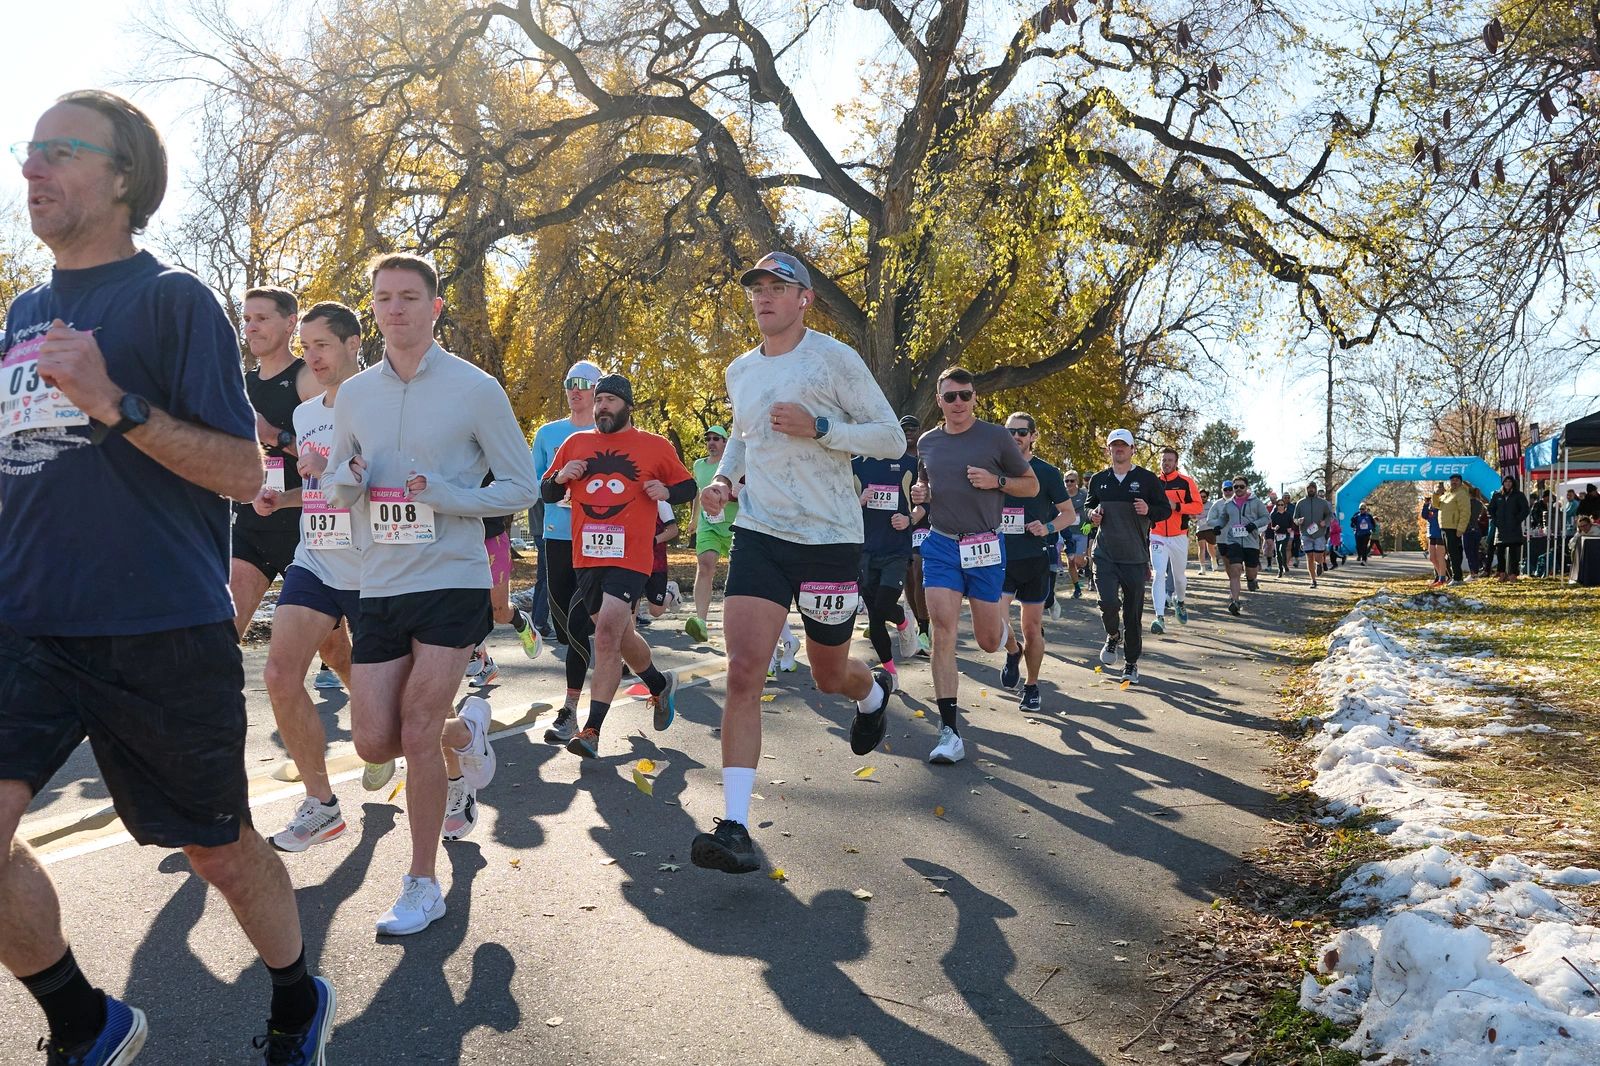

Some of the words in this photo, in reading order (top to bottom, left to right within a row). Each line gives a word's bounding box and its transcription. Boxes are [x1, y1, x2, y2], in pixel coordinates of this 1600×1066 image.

[10, 363, 54, 395] 03
[1377, 464, 1417, 474] FLEET
[1434, 464, 1468, 474] FEET
[873, 492, 892, 501] 028
[380, 504, 417, 522] 008
[310, 515, 336, 531] 037
[591, 533, 614, 546] 129
[970, 543, 991, 556] 110
[814, 595, 845, 610] 148
